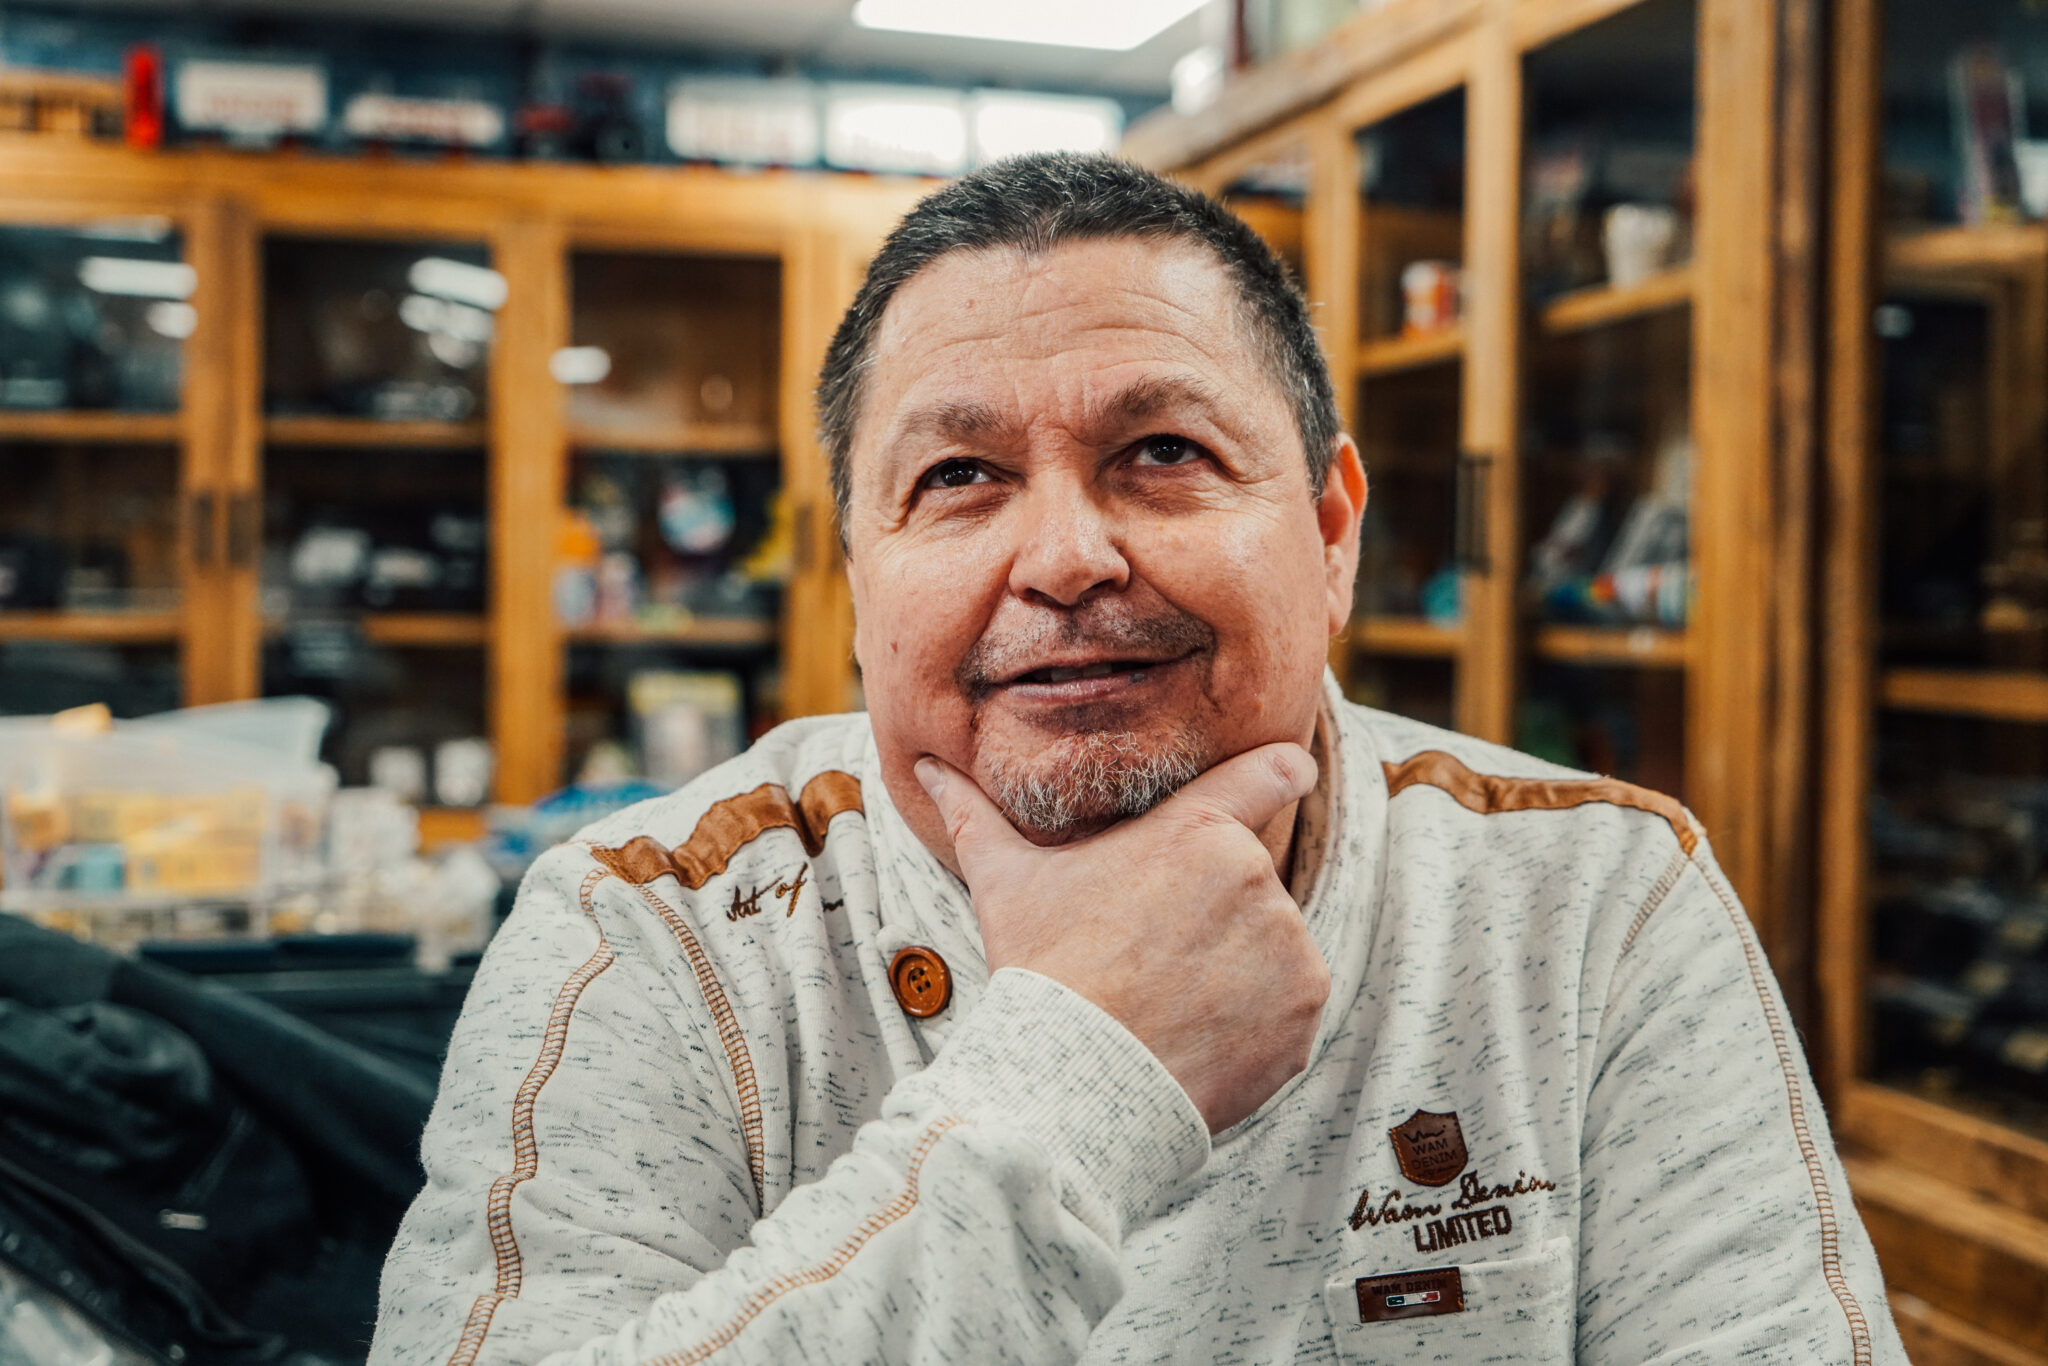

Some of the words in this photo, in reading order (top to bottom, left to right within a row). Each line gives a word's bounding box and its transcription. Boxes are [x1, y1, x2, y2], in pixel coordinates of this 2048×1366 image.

[1412, 1138, 1448, 1155] WAM
[1411, 1149, 1457, 1170] DENIM
[1349, 1190, 1442, 1231] Wam
[1413, 1205, 1512, 1252] LIMITED
[1371, 1283, 1402, 1295] WAM
